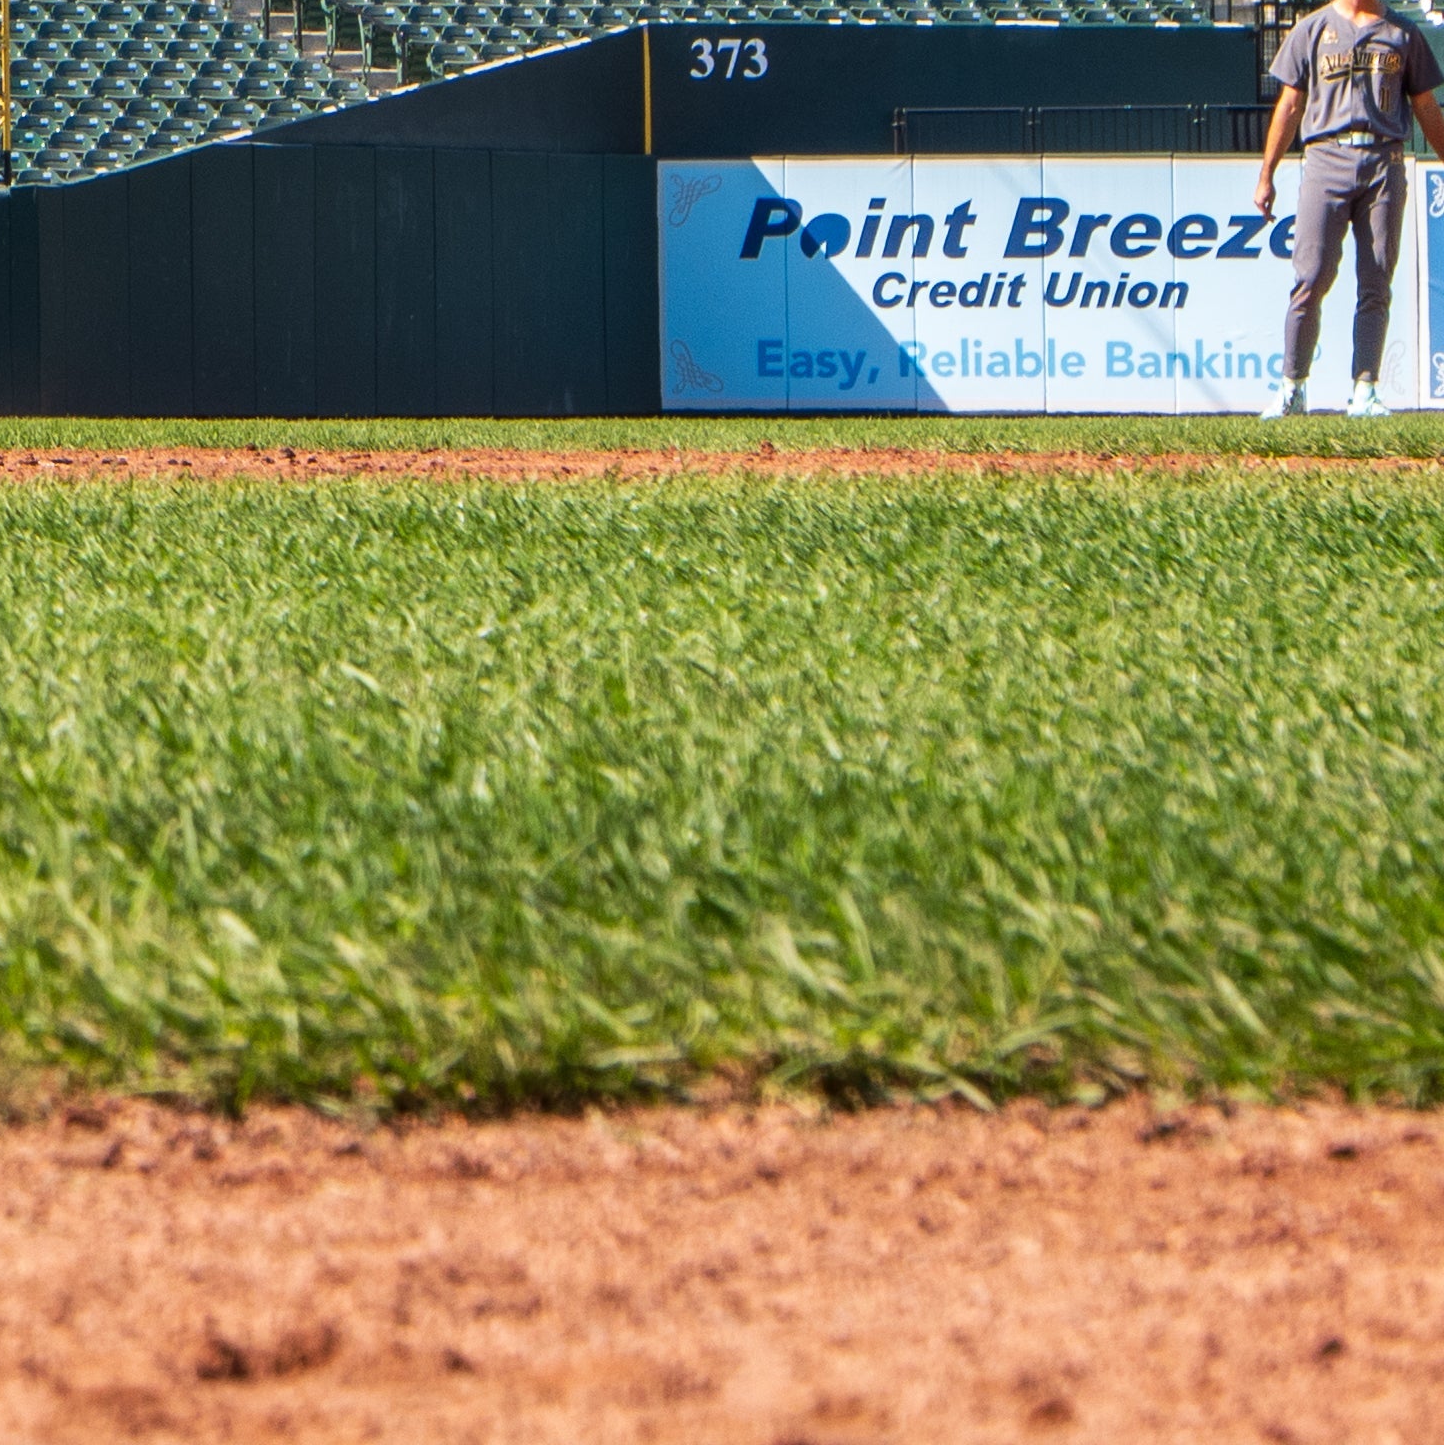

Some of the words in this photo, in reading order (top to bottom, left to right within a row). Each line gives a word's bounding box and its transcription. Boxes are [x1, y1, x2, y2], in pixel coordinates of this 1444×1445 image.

[689, 37, 769, 80] 373
[738, 196, 977, 261] Point
[871, 269, 1030, 310] Credit
[1043, 271, 1190, 310] Union
[757, 339, 880, 389] Easy,
[899, 337, 1087, 381] Reliable
